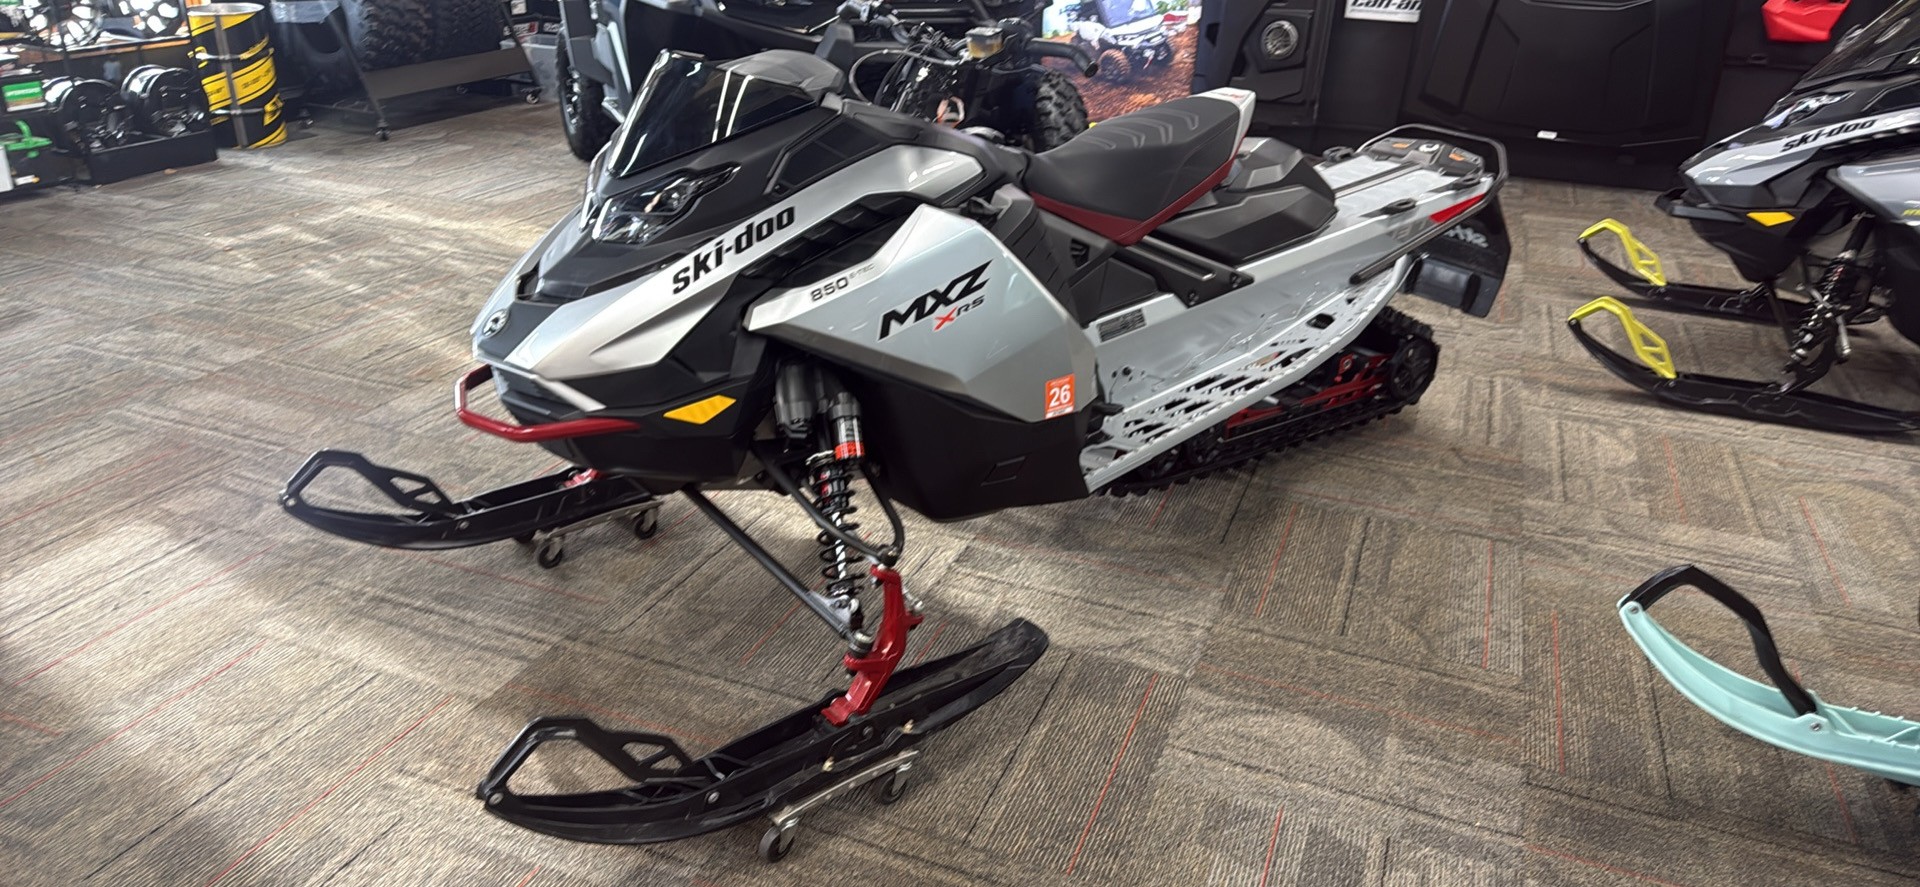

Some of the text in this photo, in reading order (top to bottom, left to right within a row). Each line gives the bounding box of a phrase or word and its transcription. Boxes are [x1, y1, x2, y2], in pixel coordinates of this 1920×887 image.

[1780, 119, 1878, 152] ski-doo
[672, 207, 795, 295] ski-doo
[811, 277, 849, 302] 850
[878, 259, 993, 340] MXZ
[1049, 384, 1071, 408] 26
